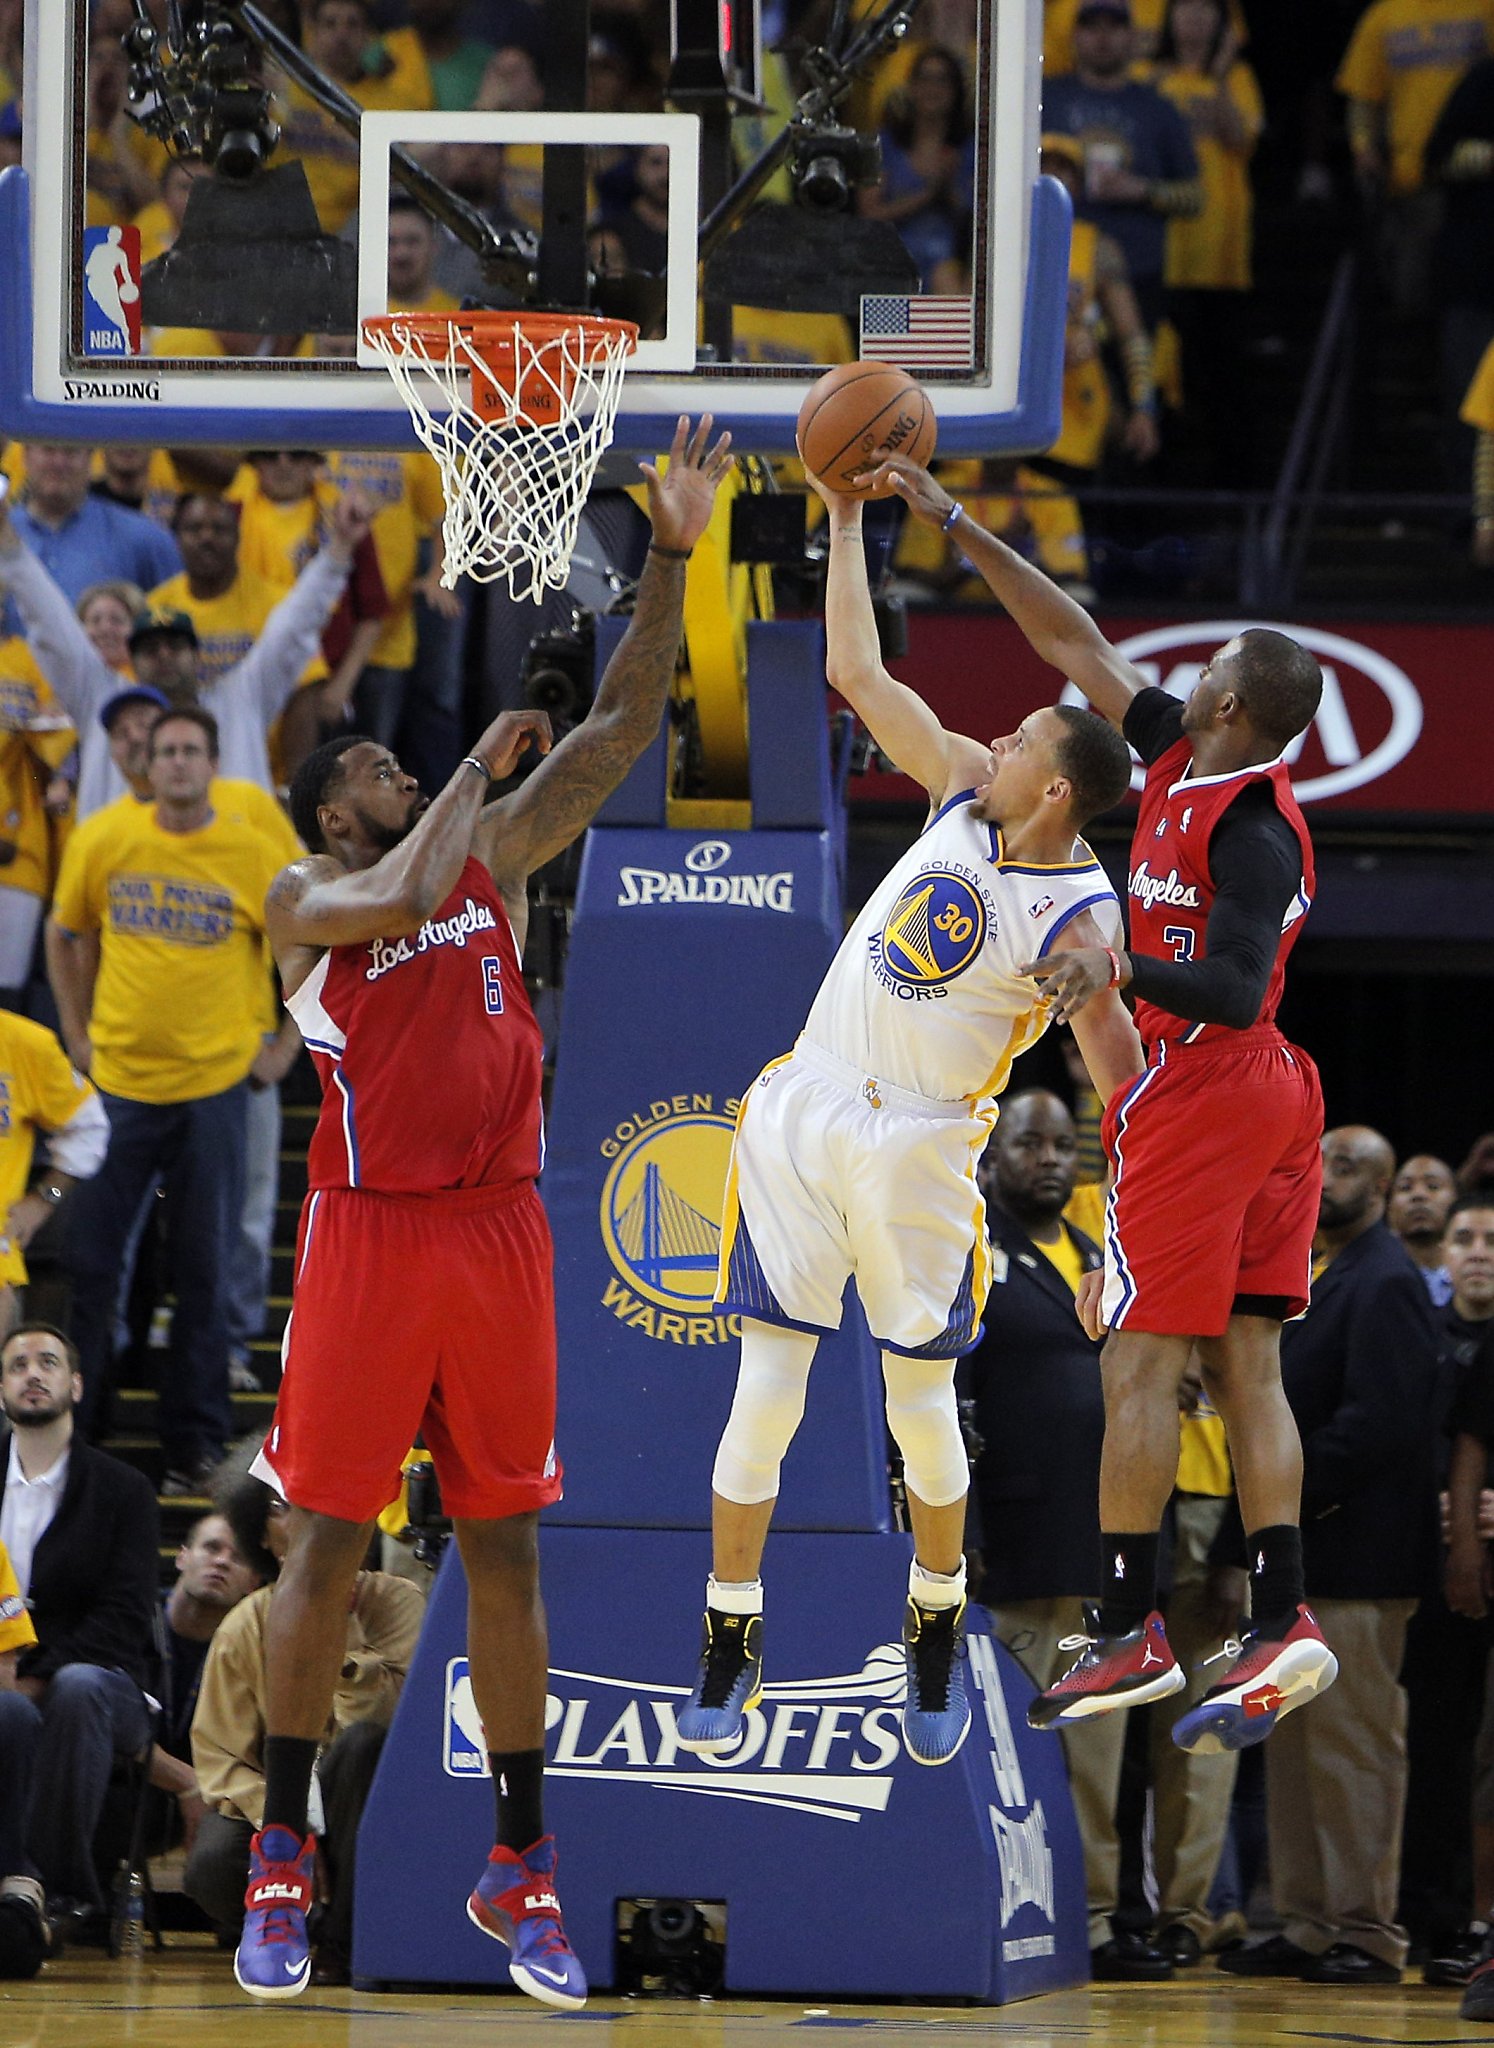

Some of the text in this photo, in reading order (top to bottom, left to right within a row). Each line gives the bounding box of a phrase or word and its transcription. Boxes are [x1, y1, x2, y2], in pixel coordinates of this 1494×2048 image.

[90, 330, 122, 350] NBA
[64, 380, 160, 401] SPALDING
[618, 866, 795, 913] SPALDING
[920, 860, 998, 943] GOLDEN STATE
[1128, 861, 1200, 910] Angeles
[366, 898, 497, 981] Los Angeles
[933, 902, 974, 943] 30
[481, 956, 505, 1015] 6
[867, 930, 949, 1001] WARRIORS
[600, 1093, 712, 1159] GOLDEN
[601, 1277, 742, 1346] WARRIO
